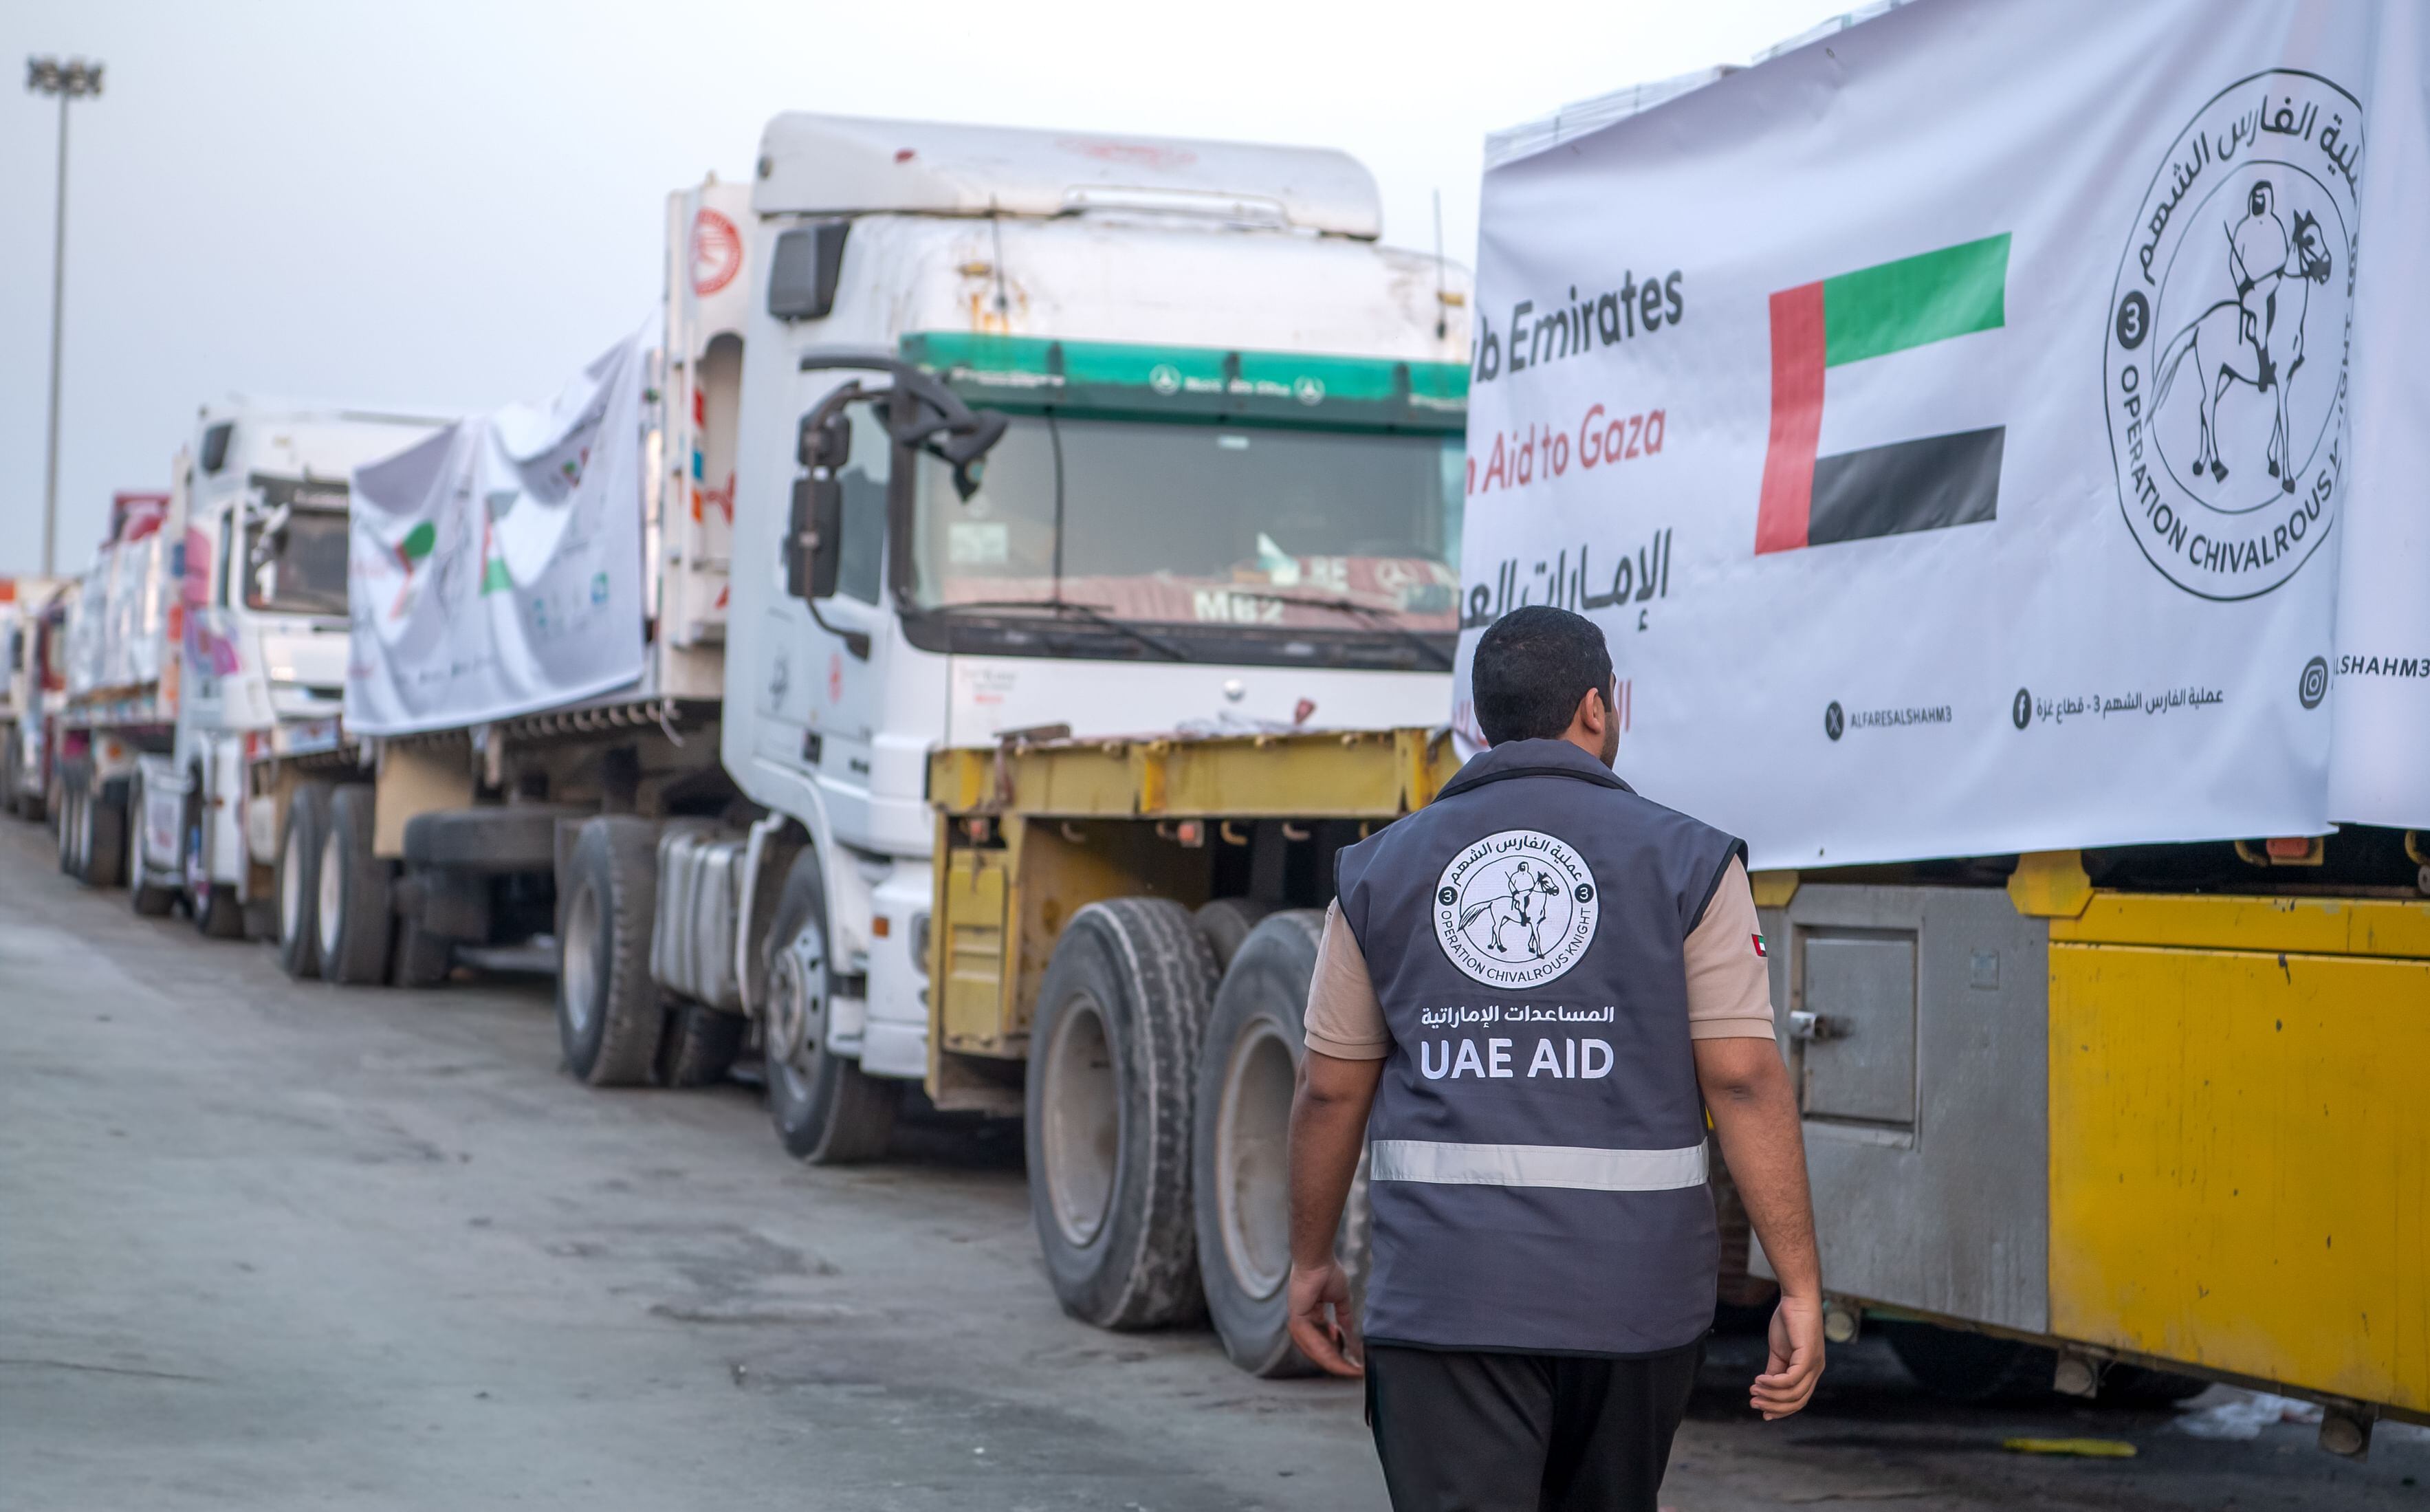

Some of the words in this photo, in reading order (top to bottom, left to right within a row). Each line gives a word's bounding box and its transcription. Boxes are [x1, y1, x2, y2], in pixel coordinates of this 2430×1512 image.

[2218, 94, 2319, 162] الفارس
[2140, 130, 2211, 287] الشهم
[1509, 268, 1683, 373] Emirates
[2124, 300, 2141, 341] 3
[1482, 421, 1535, 494] Aid
[1542, 423, 1569, 480] to
[1579, 402, 1667, 470] Gaza
[2121, 364, 2189, 553] OPERATION
[2189, 469, 2332, 573] CHIVALROUS
[2037, 697, 2054, 722] غزة
[2056, 696, 2084, 725] قطاع
[2094, 694, 2101, 713] 3
[2103, 691, 2142, 721] الشهم
[2146, 688, 2186, 714] الفارس
[2189, 686, 2224, 710] عملية
[1850, 705, 1953, 729] ALFARESALSHAHM3
[1496, 835, 1551, 854] الفارس
[1450, 841, 1493, 888] الشهم
[1550, 844, 1583, 882] عملية
[1441, 910, 1487, 975] OPERATION
[1487, 953, 1569, 983] CHIVALROUS
[1566, 907, 1592, 956] KNIGHT
[1420, 1005, 1500, 1030] الإماراتية
[1504, 1005, 1615, 1025] المساعدات
[1421, 1037, 1514, 1080] UAE
[1526, 1037, 1615, 1080] AID
